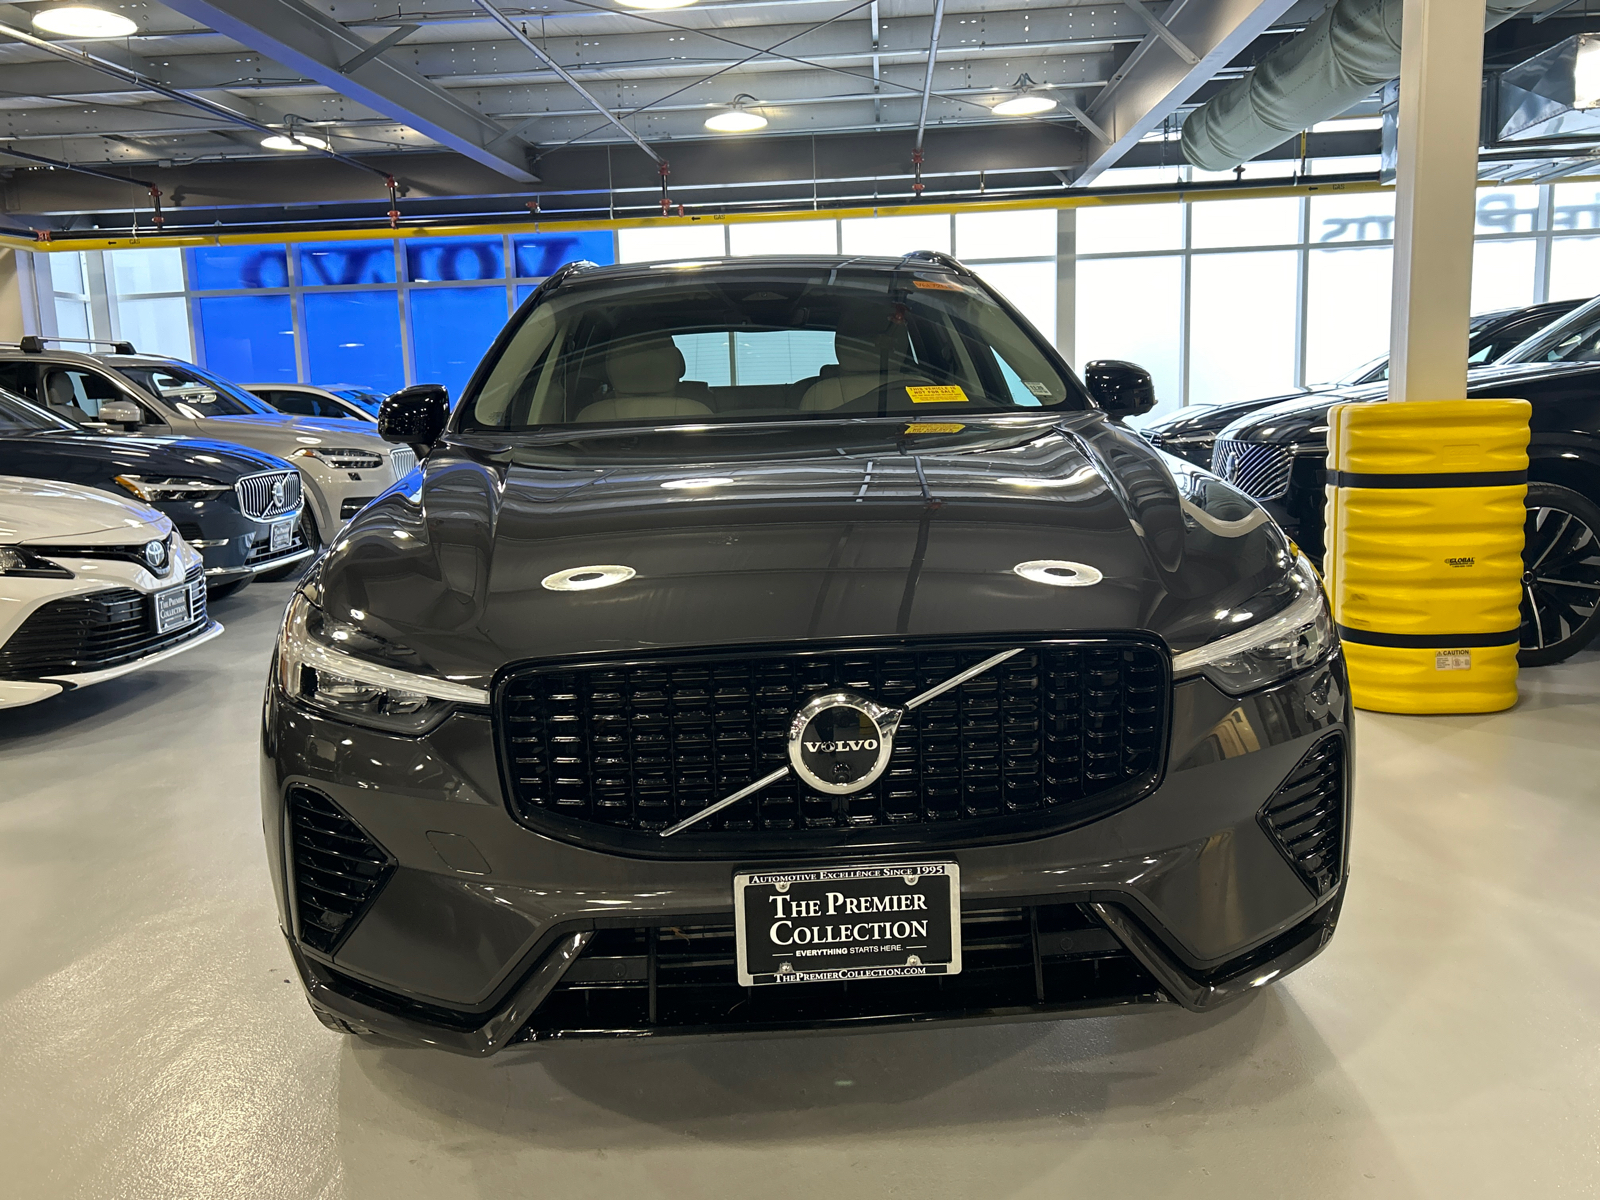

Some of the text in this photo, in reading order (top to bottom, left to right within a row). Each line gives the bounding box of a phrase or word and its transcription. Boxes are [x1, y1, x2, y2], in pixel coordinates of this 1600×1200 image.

[803, 739, 878, 753] VOLVO
[751, 866, 943, 884] AUTOMOTIVE EXCELLENCE SINCE 1995
[769, 891, 928, 919] THE PREMIER
[769, 919, 928, 946] COLLECTION
[795, 944, 904, 957] EVERYTHING STARTS HERE.
